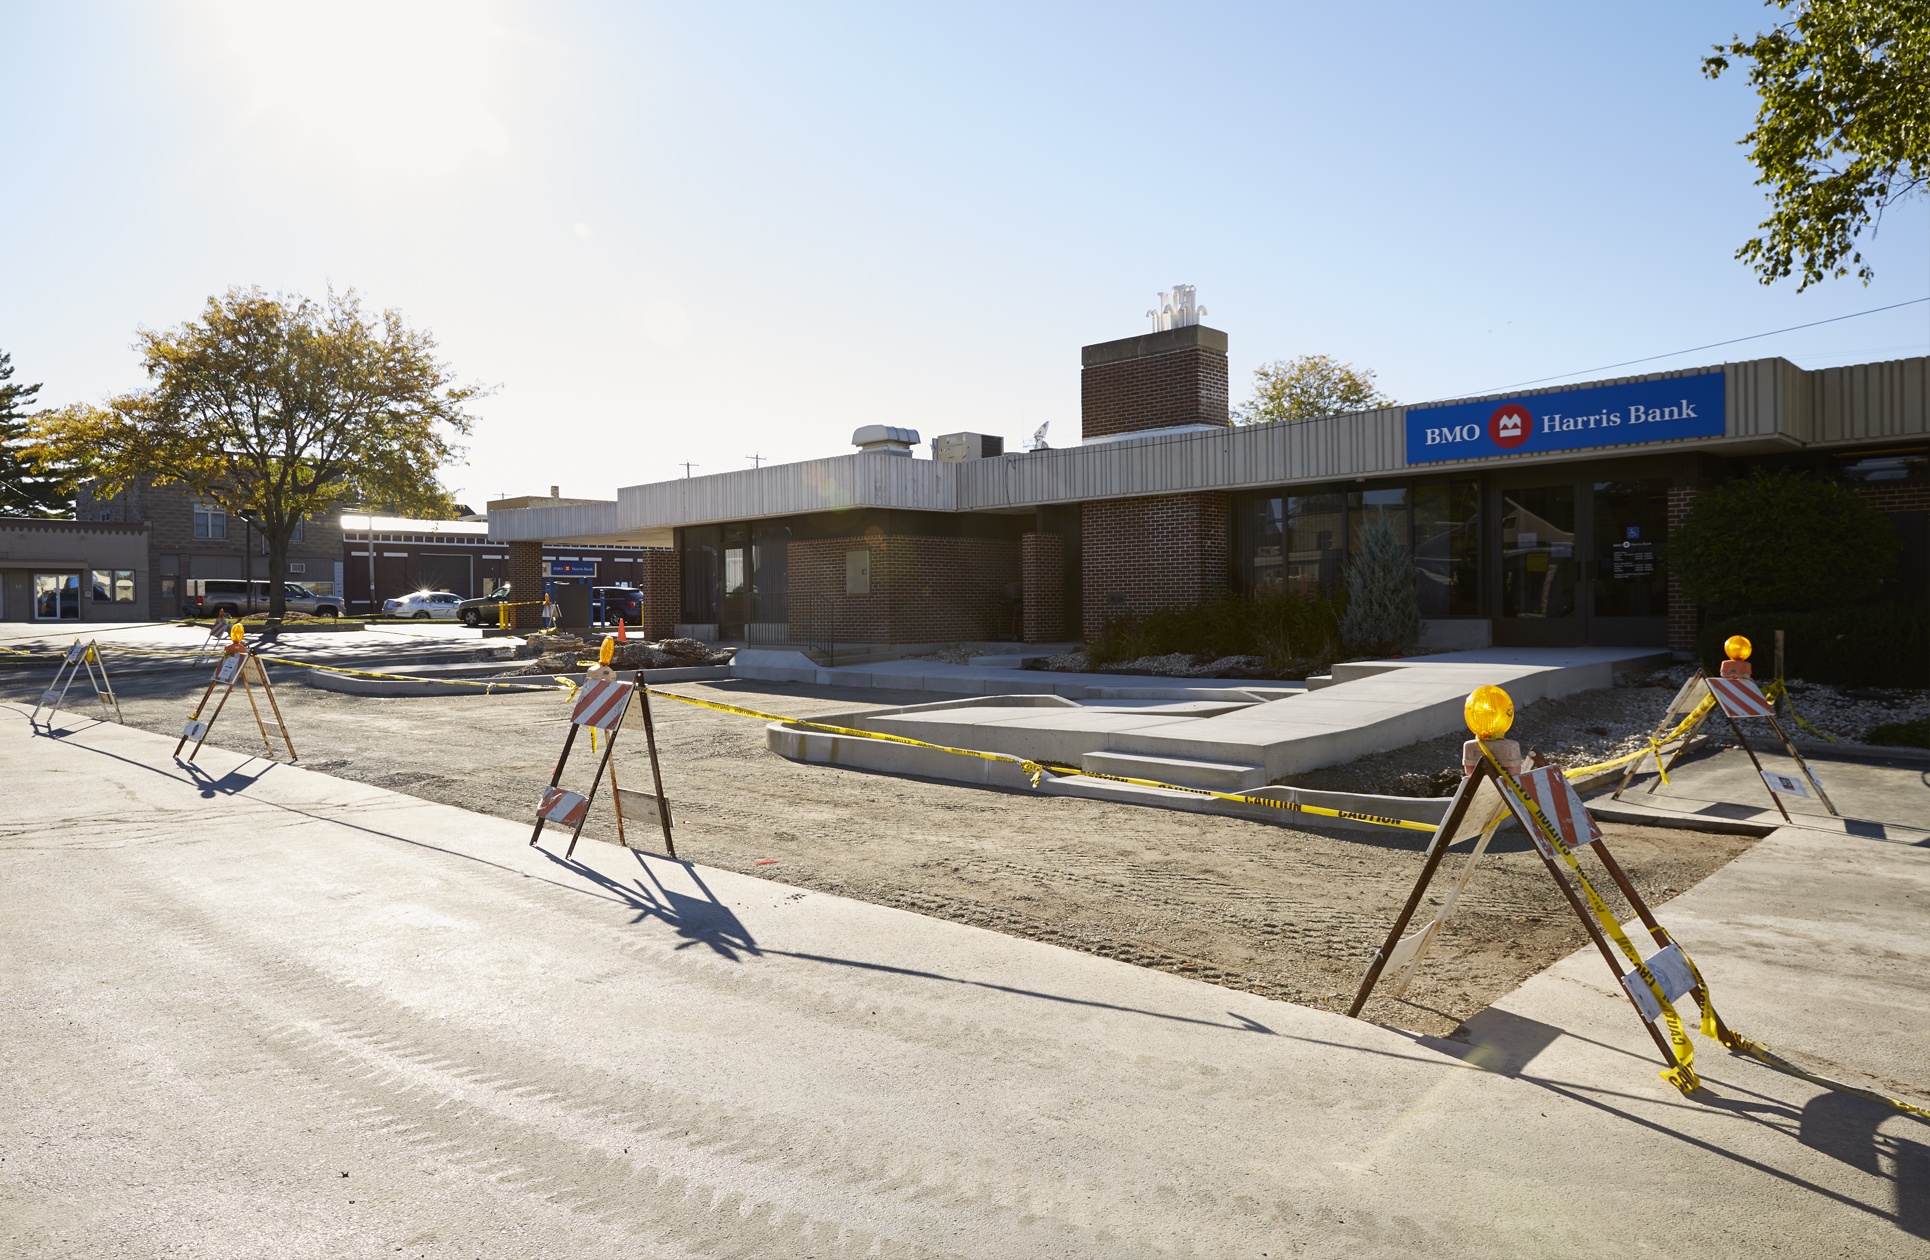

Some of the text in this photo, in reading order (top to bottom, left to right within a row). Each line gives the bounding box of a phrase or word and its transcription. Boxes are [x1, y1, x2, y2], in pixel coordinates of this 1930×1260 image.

[1425, 400, 1698, 446] BMO Harris Bank
[1338, 810, 1402, 825] CAUTION
[1535, 809, 1571, 857] CAUTION
